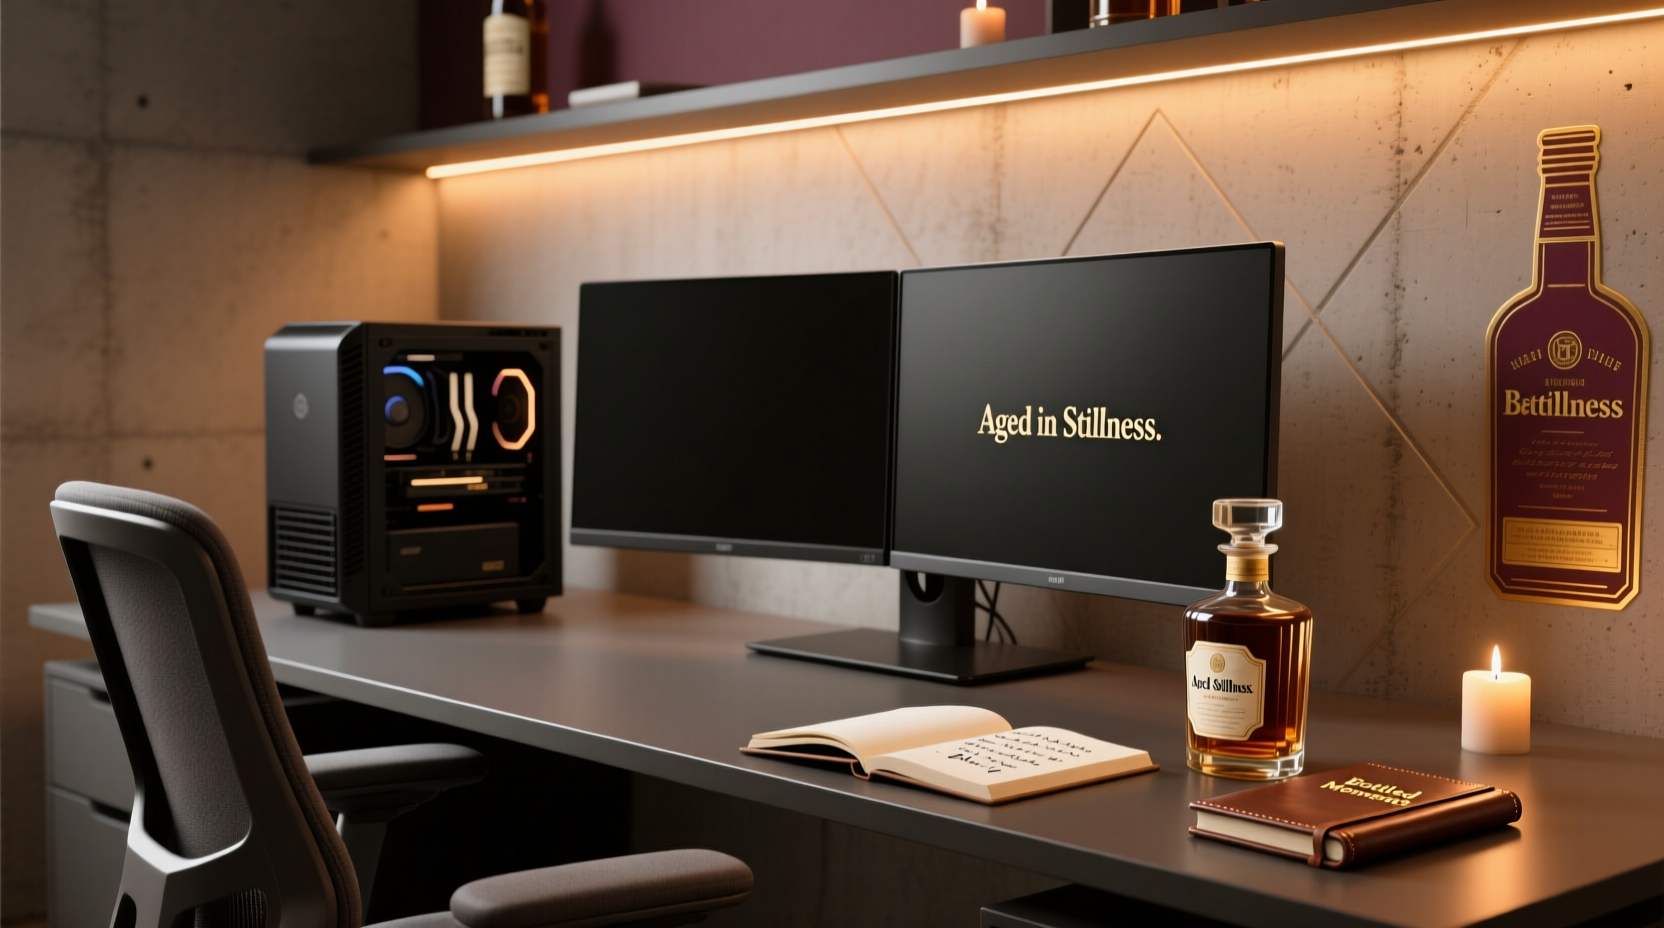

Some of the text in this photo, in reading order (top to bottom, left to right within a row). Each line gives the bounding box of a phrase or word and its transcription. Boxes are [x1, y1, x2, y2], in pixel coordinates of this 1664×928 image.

[977, 403, 1162, 443] Aged in Stillness.
[1344, 776, 1423, 799] Bottled
